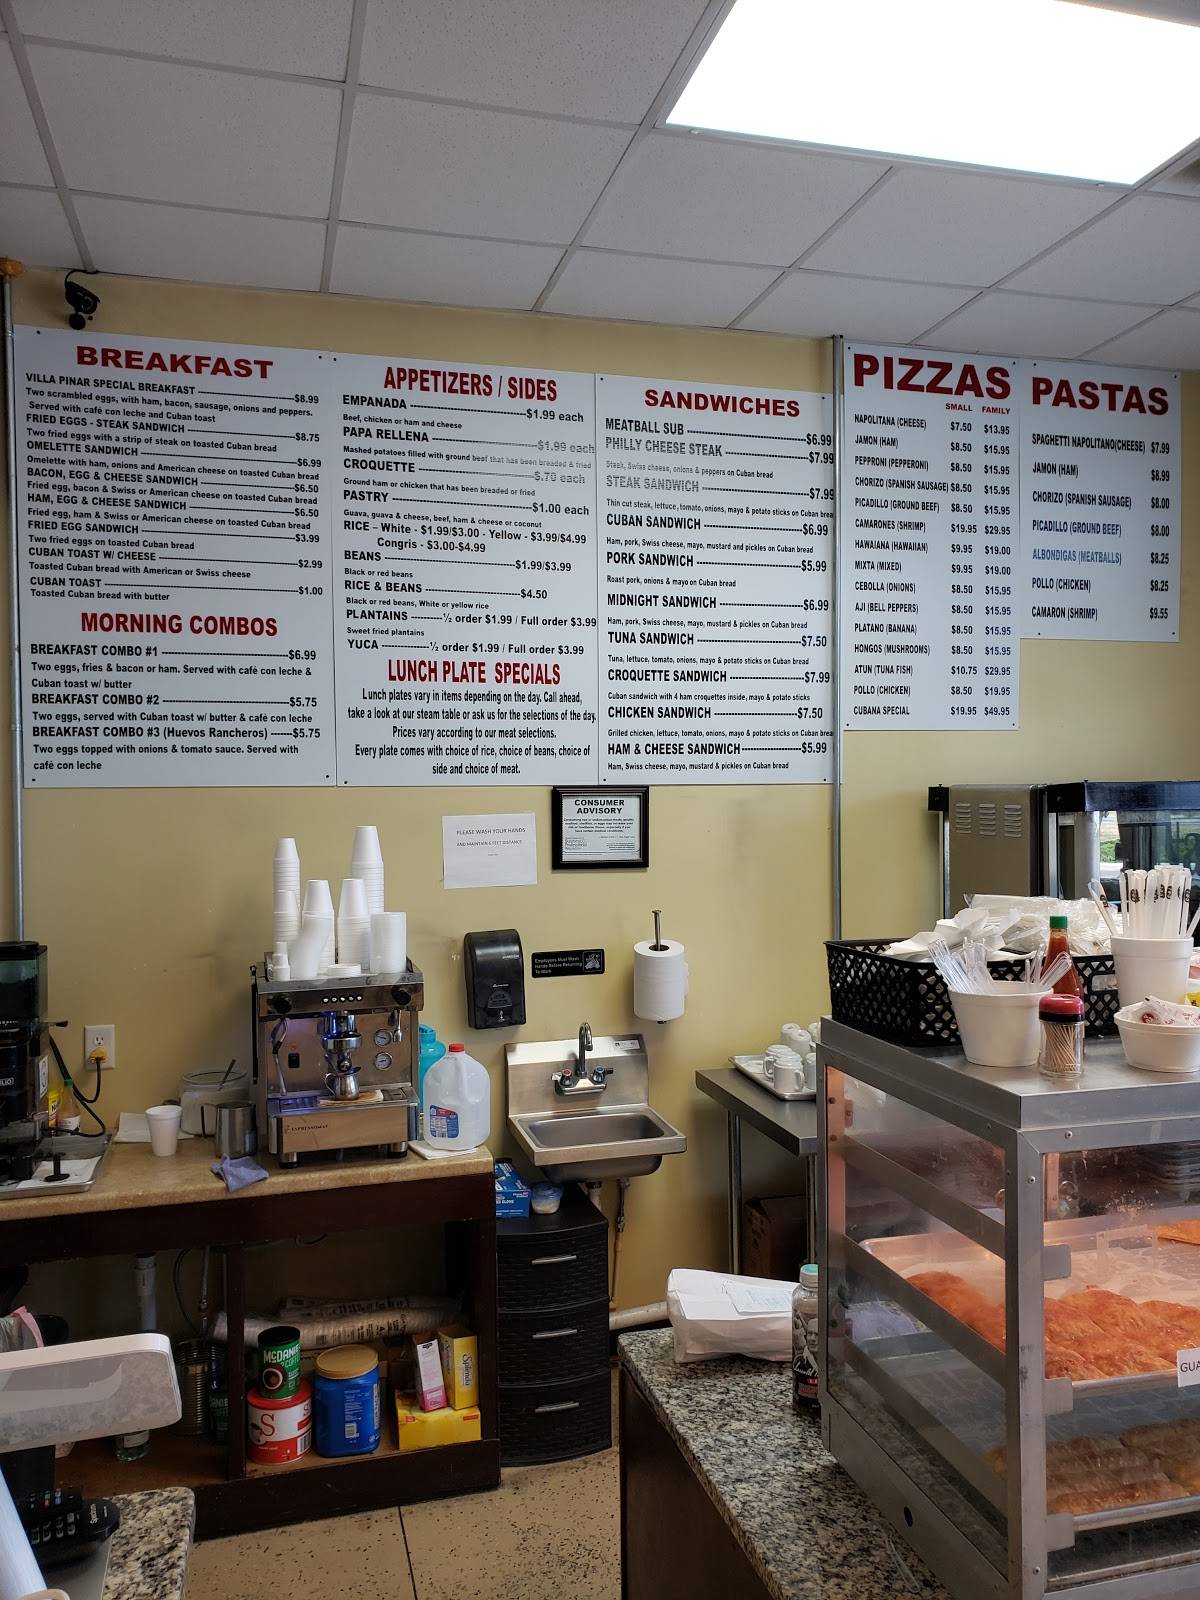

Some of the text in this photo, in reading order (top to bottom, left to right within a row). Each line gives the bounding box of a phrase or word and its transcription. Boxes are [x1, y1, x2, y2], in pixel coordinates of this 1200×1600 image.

[77, 346, 274, 379] BREAKFAST
[384, 367, 493, 396] APPETIZERS
[508, 377, 557, 402] SIDES
[854, 354, 1011, 400] PIZZAS
[26, 373, 319, 404] VILLA PINAR SPECIAL BREAKFAST $8.99
[1032, 376, 1169, 416] PASTAS
[343, 395, 584, 422] EMPANADA $1.99 each
[645, 390, 800, 417] SANDWICHES
[946, 403, 1010, 415] SMALL FAMILY
[343, 426, 429, 442] PAPA RELLENA
[606, 418, 832, 446] MEATBALL SUB $6.99
[854, 414, 1010, 435] NAPOLITANA (CHEESE) $7.50 $13.95
[27, 440, 322, 468] OMELETTE SANDWICH $6.99
[606, 437, 722, 457] PHILLY CHEESE STEAK
[855, 435, 1010, 455] JAMON (HAM) $8.50 $15.95
[344, 458, 415, 473] CROQUETTE
[1033, 462, 1170, 482] JAMON (HAM) $8.99
[344, 490, 589, 515] PASTRY $1.00 each
[607, 514, 828, 536] CUBAN SANDWICH $6.99
[28, 535, 47, 543] Two
[49, 536, 69, 544] fried
[72, 538, 93, 547] eggs
[108, 538, 140, 547] toasted
[142, 540, 169, 548] Cuban
[171, 541, 195, 550] bread
[28, 547, 64, 557] CUBAN
[67, 549, 100, 559] TOAST
[117, 551, 156, 561] CHEESE
[298, 559, 323, 569] $2.99
[344, 551, 571, 572] BEANS $1.99/$3.99
[607, 552, 827, 572] PORK SANDWICH $5.99
[346, 610, 408, 621] PLANTAINS
[1032, 606, 1168, 621] CAMARON (SHRIMP) $9.55
[81, 612, 277, 637] MORNING COMBOS
[31, 644, 316, 660] BREAKFAST COMBO #1 $6.99
[347, 640, 379, 649] YUCA
[442, 642, 469, 652] order
[472, 643, 499, 653] $1.99
[508, 644, 526, 654] Full
[529, 645, 555, 654] order
[558, 645, 584, 655] $3.99
[388, 659, 560, 685] LUNCH PLATE SPECIALS
[854, 665, 1011, 676] ATUN (TUNA FISH) $10.75 $29.95
[608, 706, 823, 719] CHICKEN SANDWICH $7.50
[854, 706, 1010, 716] CUBANA SPECIAL $19.95 $49.95
[32, 726, 320, 740] BREAKFAST COMBO #3 (Huevos Rancheros) $5.75
[393, 726, 557, 740] Prices vary according to our meat selections.
[608, 744, 630, 755] HAM
[645, 743, 684, 755] CHEESE
[688, 743, 740, 755] SANDWICH
[802, 742, 827, 754] $5.99
[77, 760, 102, 770] leche
[625, 762, 643, 770] Swiss
[689, 762, 714, 770] mustard
[722, 762, 743, 771] pickles
[462, 1352, 472, 1386] Splenda
